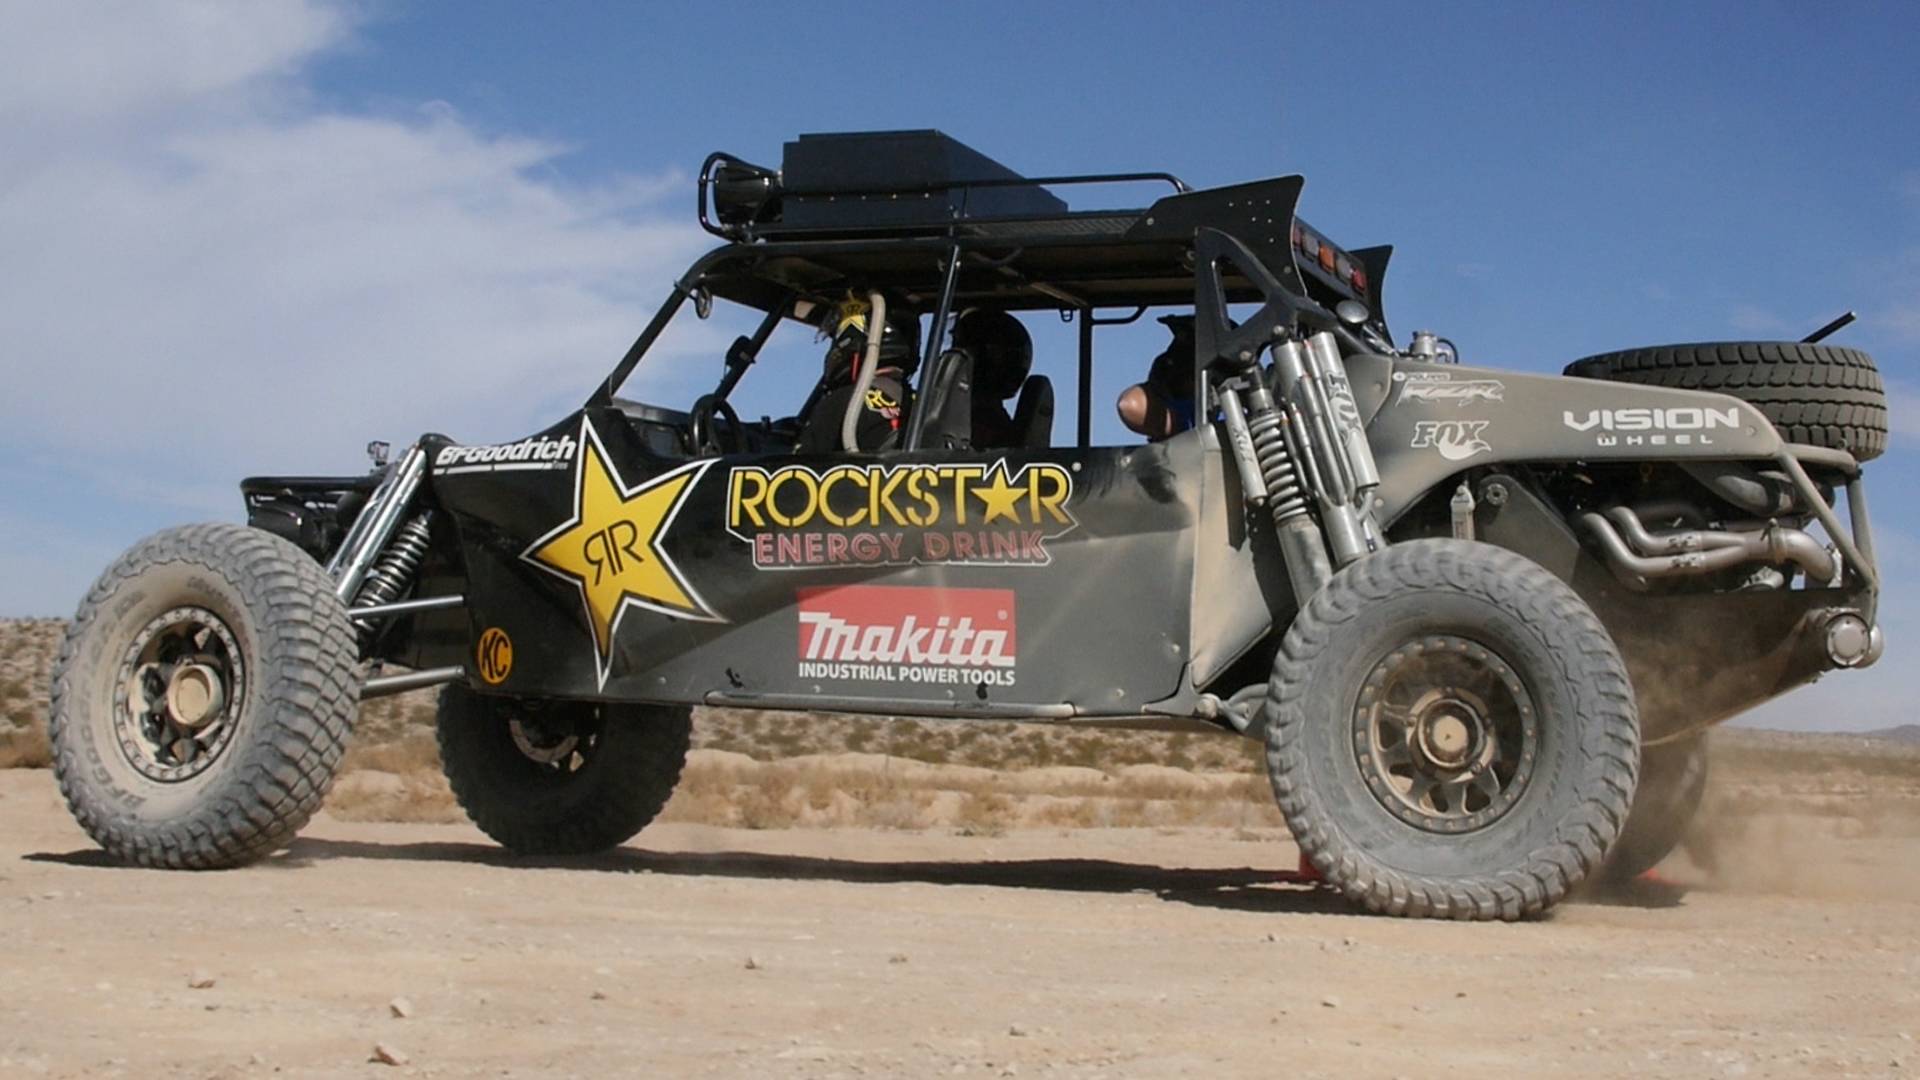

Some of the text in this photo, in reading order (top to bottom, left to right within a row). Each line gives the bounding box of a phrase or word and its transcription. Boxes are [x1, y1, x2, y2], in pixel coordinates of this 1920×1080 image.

[1563, 408, 1740, 431] VISION
[1411, 421, 1490, 449] FOX
[1597, 434, 1714, 446] WHEEL
[756, 530, 1045, 564] ENERGY DRINK
[799, 611, 1016, 667] Makita
[481, 631, 508, 680] KC
[799, 663, 1015, 686] INDUSTRIAL POWER TOOLS
